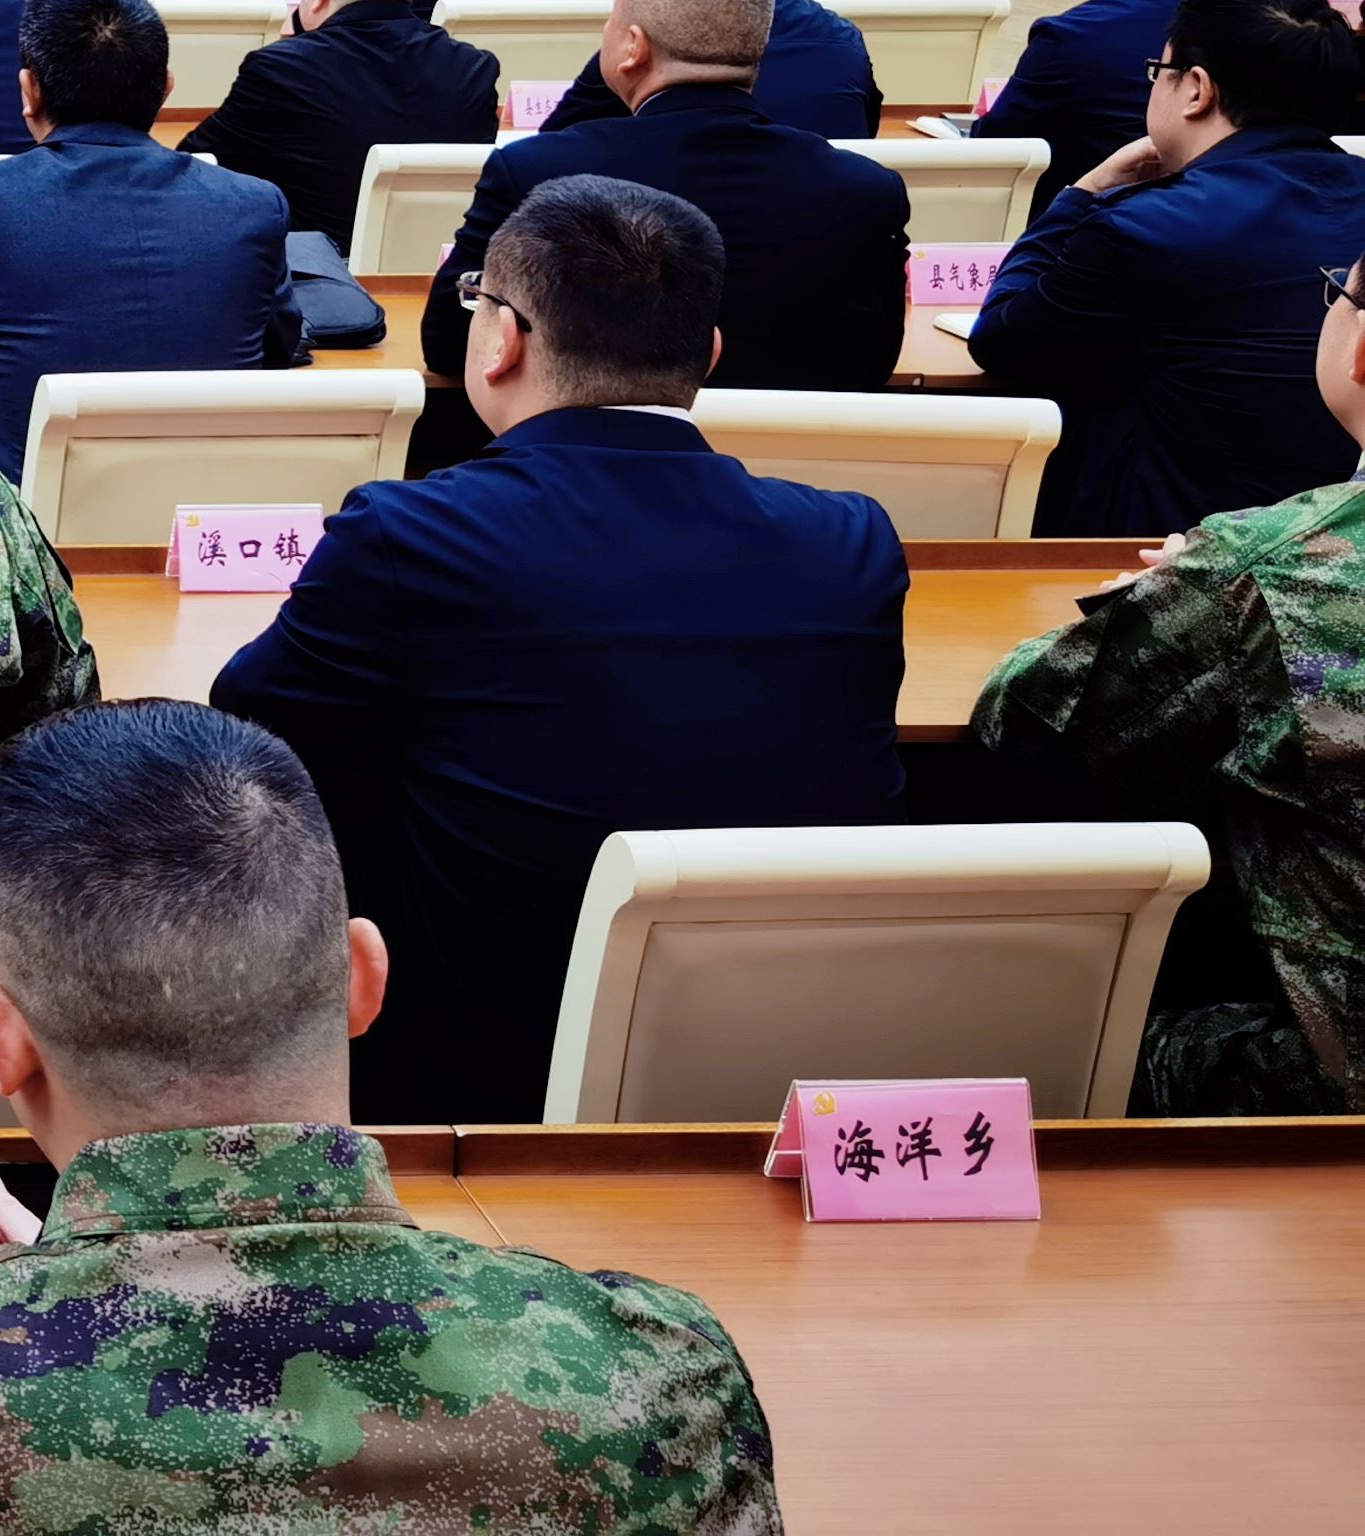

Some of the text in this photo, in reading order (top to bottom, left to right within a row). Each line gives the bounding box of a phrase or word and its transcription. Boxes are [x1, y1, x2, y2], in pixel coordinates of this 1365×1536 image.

[198, 527, 307, 567] 溪口镇
[834, 1111, 995, 1183] 海洋乡
